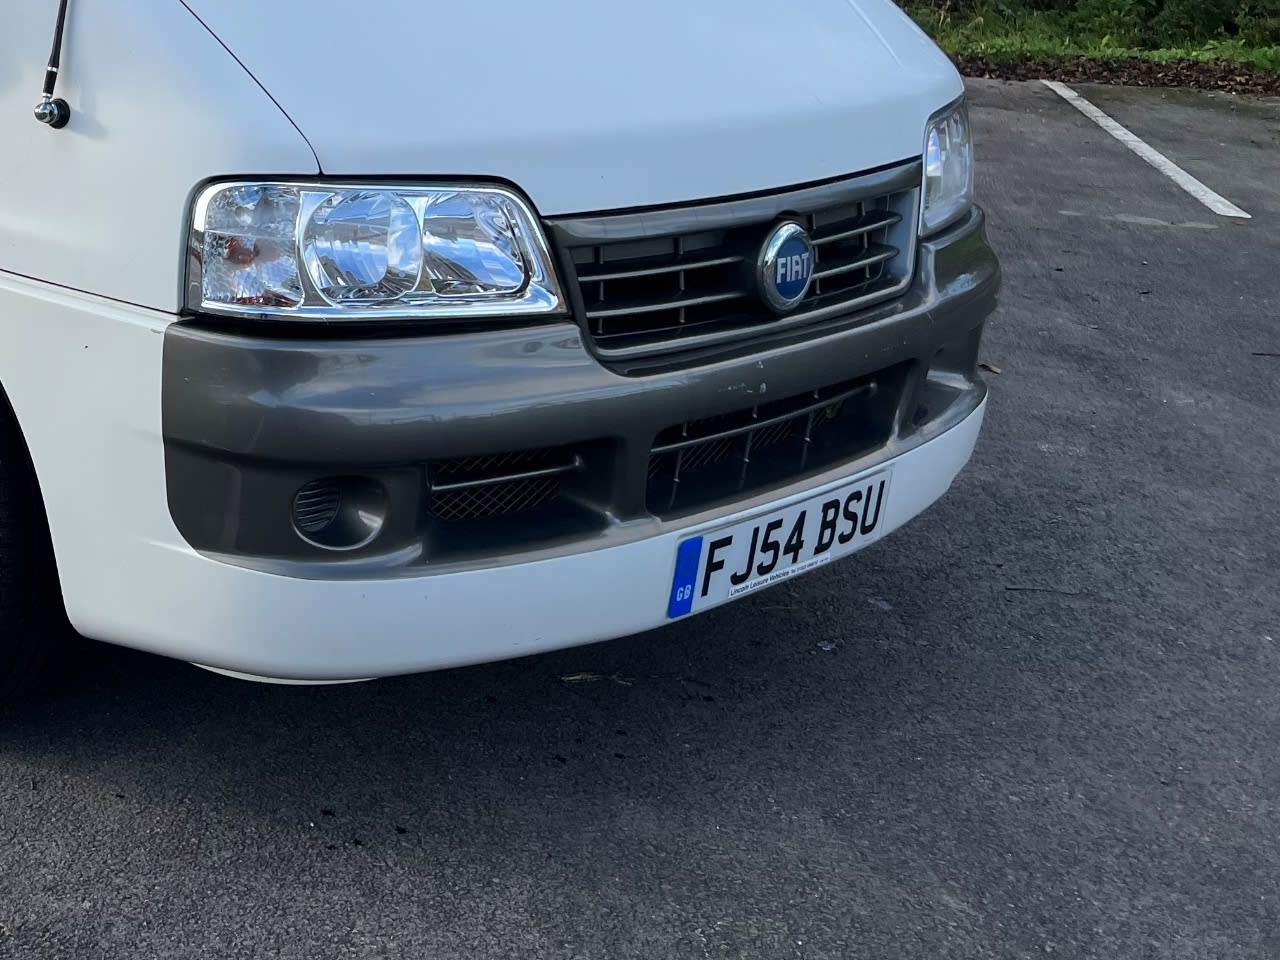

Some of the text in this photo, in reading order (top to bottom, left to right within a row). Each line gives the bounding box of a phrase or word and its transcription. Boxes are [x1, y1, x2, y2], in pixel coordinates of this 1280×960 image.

[776, 252, 810, 284] FIAT
[701, 480, 886, 597] FJ54 BSU
[676, 584, 692, 602] GB
[730, 584, 749, 596] Lincoln
[750, 577, 769, 589] Leisure
